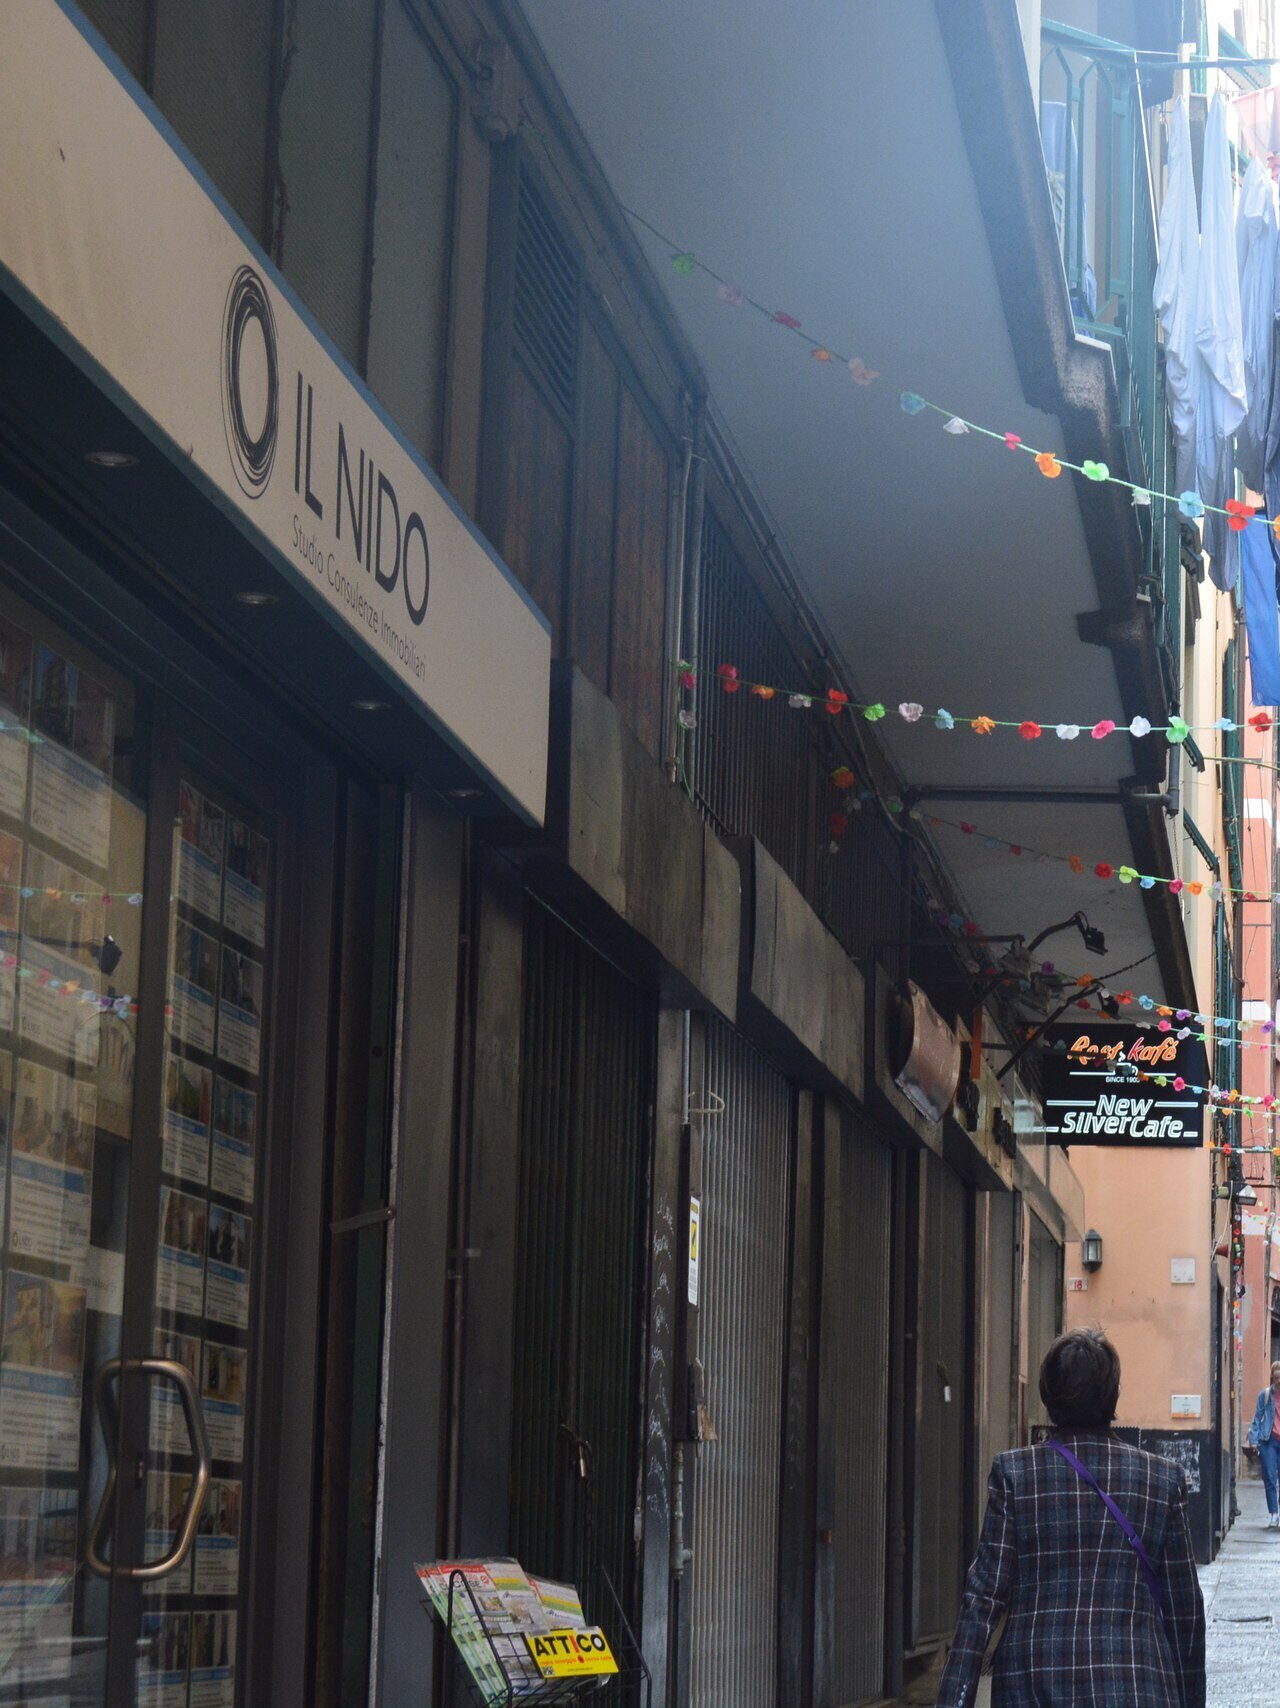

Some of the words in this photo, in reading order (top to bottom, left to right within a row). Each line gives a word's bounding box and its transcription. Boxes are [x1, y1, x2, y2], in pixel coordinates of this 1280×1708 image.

[294, 371, 323, 521] IL
[335, 421, 430, 626] NIDO
[292, 513, 324, 575] Studio
[326, 552, 379, 634] Consulenze
[1096, 1094, 1154, 1116] New
